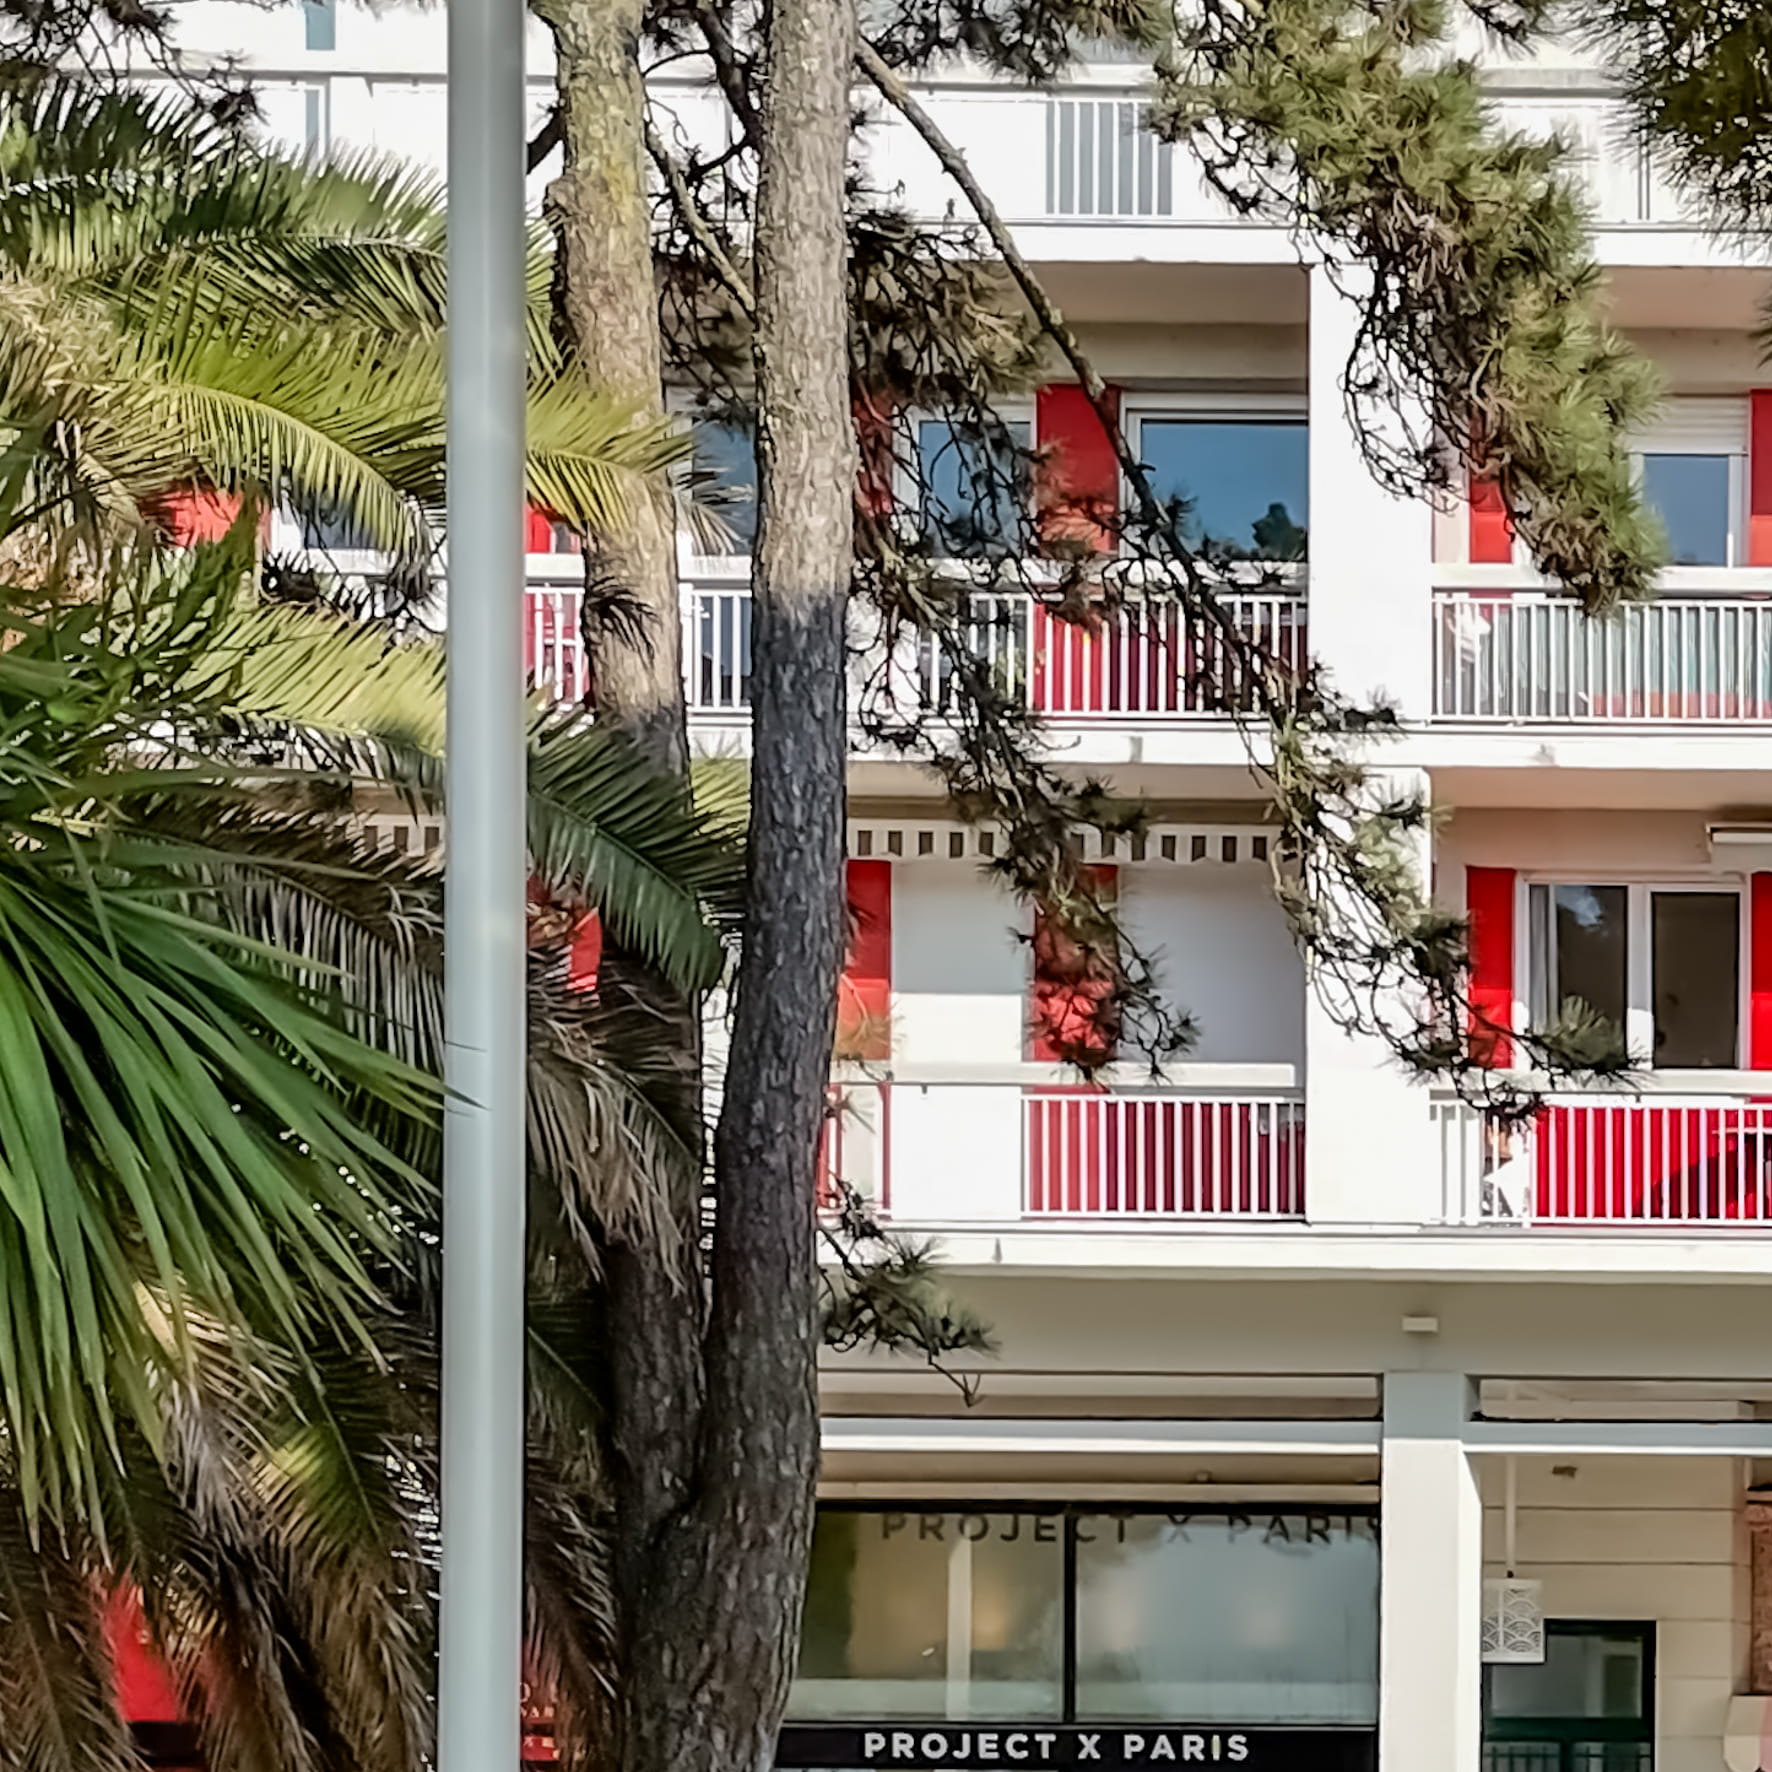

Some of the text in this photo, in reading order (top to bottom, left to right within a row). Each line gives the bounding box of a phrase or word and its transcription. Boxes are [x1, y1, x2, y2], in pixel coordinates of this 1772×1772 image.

[882, 1513, 1132, 1543] PROJECT
[1166, 1513, 1192, 1543] X
[864, 1732, 1249, 1761] PROJECT X PARIS
